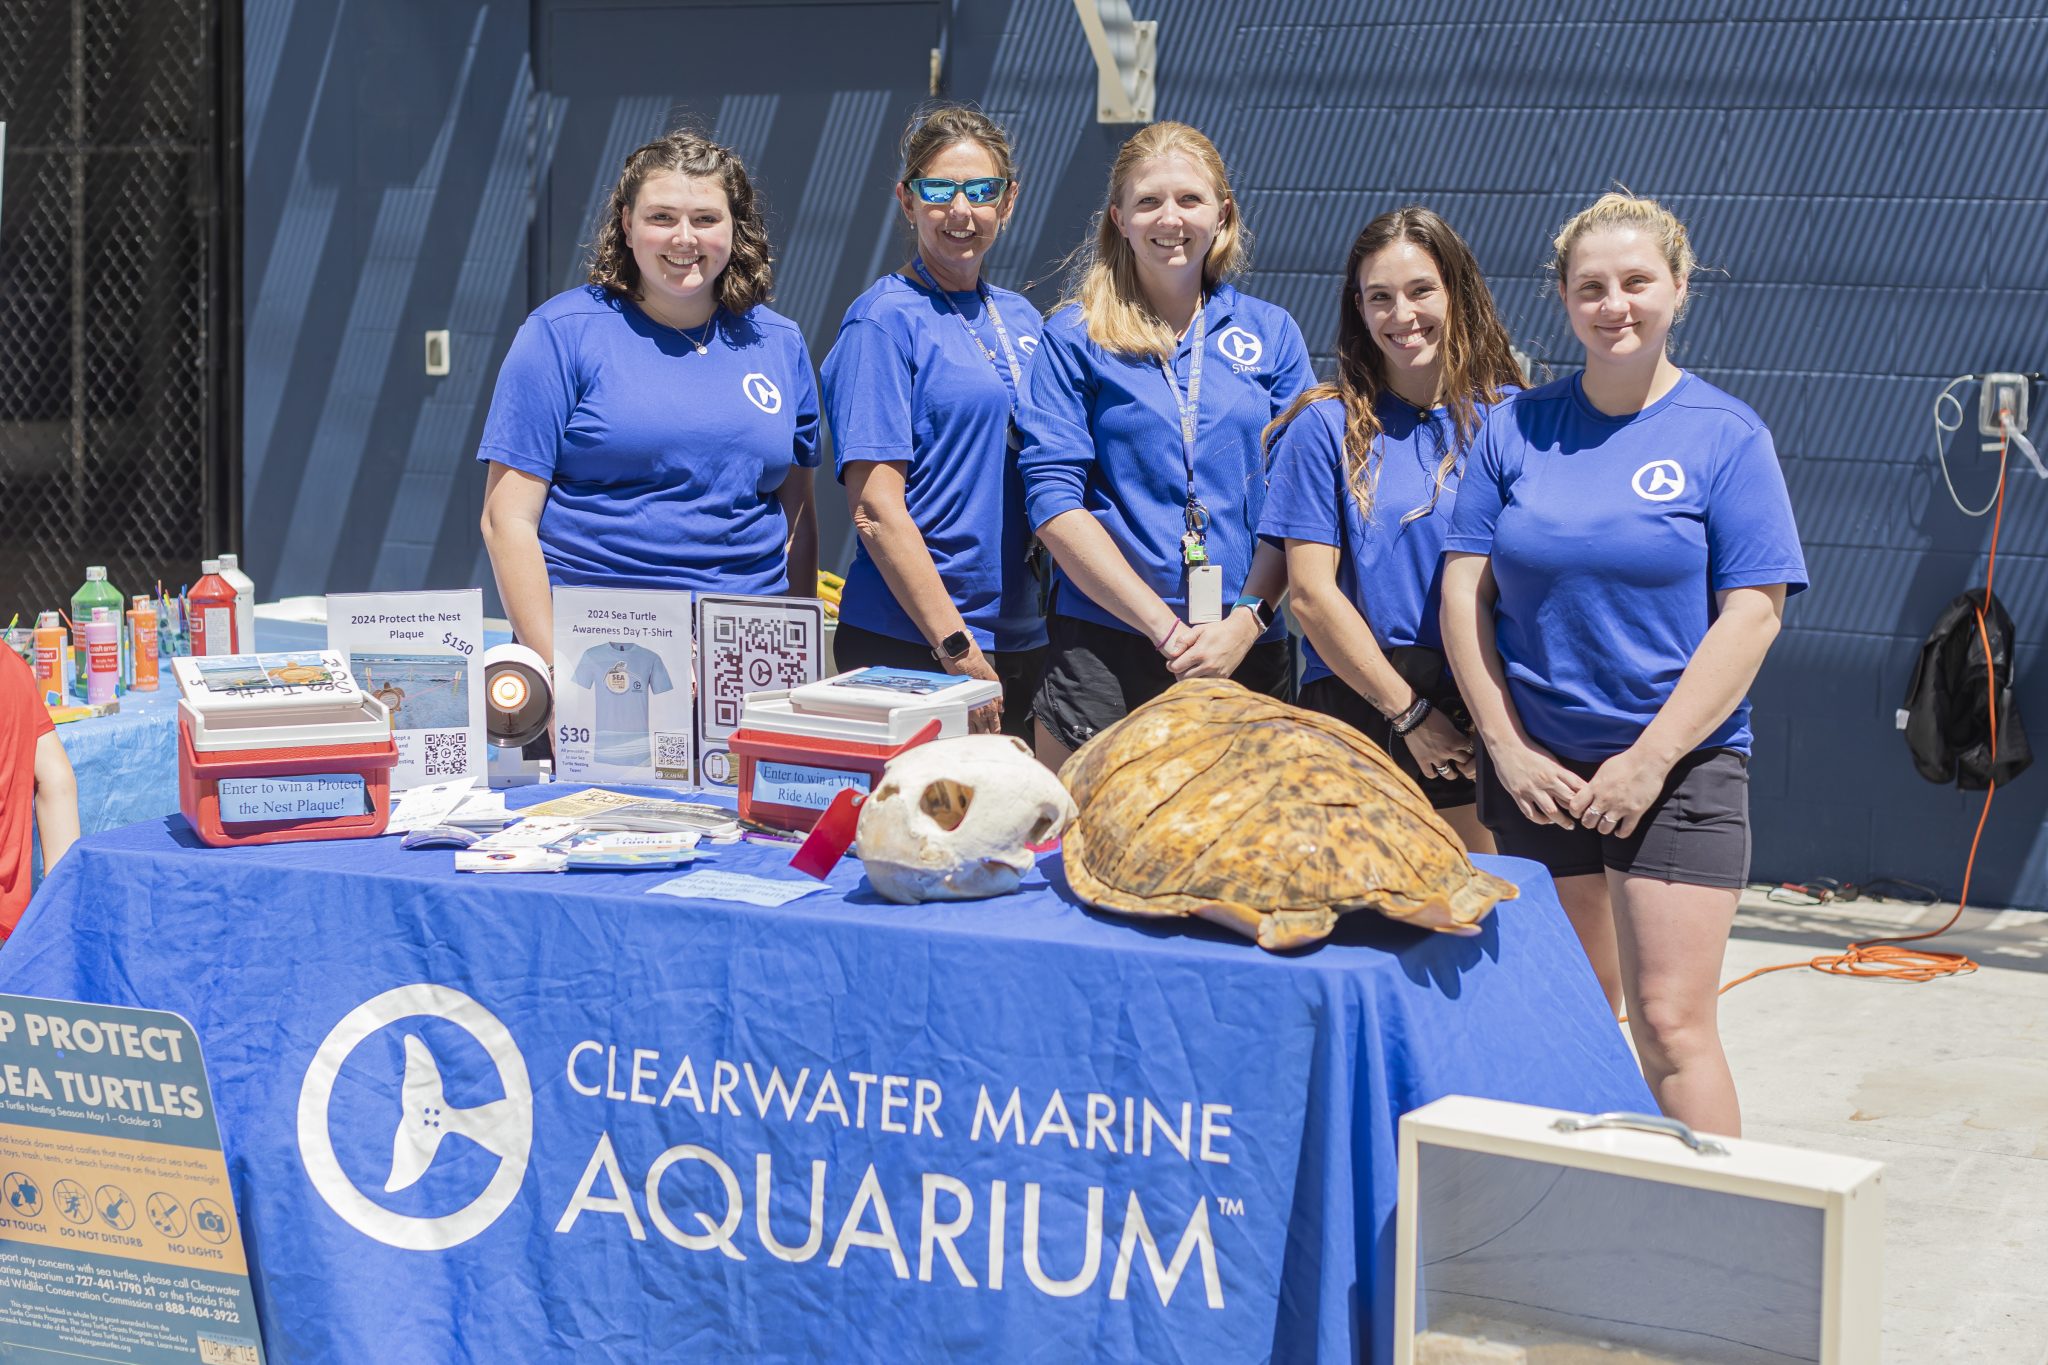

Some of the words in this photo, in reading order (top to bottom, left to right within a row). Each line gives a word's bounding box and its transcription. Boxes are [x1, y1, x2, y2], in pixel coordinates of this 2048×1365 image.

[352, 615, 376, 624] 2024
[380, 614, 415, 624] Protect
[419, 613, 434, 622] the
[438, 612, 460, 622] Nest
[588, 610, 609, 618] 2024
[612, 610, 627, 620] Sea
[630, 612, 657, 621] Turtle
[390, 630, 424, 640] Plaque
[572, 625, 620, 635] Awareness
[623, 627, 640, 638] Day
[642, 628, 672, 638] T-Shirt
[442, 632, 474, 656] $150
[225, 686, 302, 698] Turtle
[560, 725, 590, 744] $30
[222, 782, 257, 795] Enter
[262, 783, 274, 793] to
[278, 782, 300, 792] win
[307, 783, 313, 791] a
[318, 778, 363, 791] Protect
[764, 766, 792, 780] Enter
[794, 772, 804, 781] to
[808, 773, 825, 785] win
[838, 776, 860, 788] VIP
[240, 802, 259, 814] the
[263, 801, 292, 813] Nest
[297, 798, 344, 813] Plaque!
[778, 788, 802, 802] Ride
[804, 792, 833, 806] Alon
[24, 1013, 182, 1063] PROTECT
[54, 1070, 204, 1119] TURTLES
[566, 1040, 944, 1137] CLEARWATER
[970, 1084, 1234, 1164] MARINE
[5, 1100, 25, 1111] Turtle
[27, 1103, 56, 1117] Nesting
[57, 1106, 84, 1118] Season
[86, 1110, 104, 1123] May
[106, 1112, 110, 1122] 1
[119, 1114, 150, 1126] October
[152, 1118, 162, 1128] 31
[56, 1144, 74, 1152] sand
[0, 1218, 10, 1227] OT
[13, 1220, 47, 1232] TOUCH
[554, 1130, 1225, 1310] AQUARIUM
[60, 1227, 75, 1237] DO
[78, 1230, 99, 1240] NOT
[102, 1233, 143, 1247] DISTURB
[168, 1243, 185, 1253] NO
[187, 1246, 224, 1259] LIGHTS
[20, 1256, 35, 1267] any
[38, 1259, 75, 1271] concerns
[76, 1263, 94, 1274] with
[96, 1268, 111, 1277] sea
[113, 1269, 140, 1282] turtles,
[143, 1272, 171, 1286] please
[173, 1278, 189, 1289] call
[190, 1279, 240, 1296] Clearwater
[0, 1265, 21, 1276] arine
[24, 1268, 63, 1282] Aquarium
[66, 1275, 73, 1284] at
[75, 1275, 142, 1294] 727-441-1790
[144, 1286, 156, 1296] x1
[159, 1291, 169, 1299] or
[171, 1289, 184, 1301] the
[186, 1292, 217, 1306] Florida
[219, 1298, 236, 1309] Fish
[11, 1279, 44, 1293] Wildlife
[45, 1284, 100, 1302] Conservation
[102, 1293, 153, 1309] Commission
[155, 1303, 163, 1311] at
[165, 1302, 240, 1323] 888-404-3922
